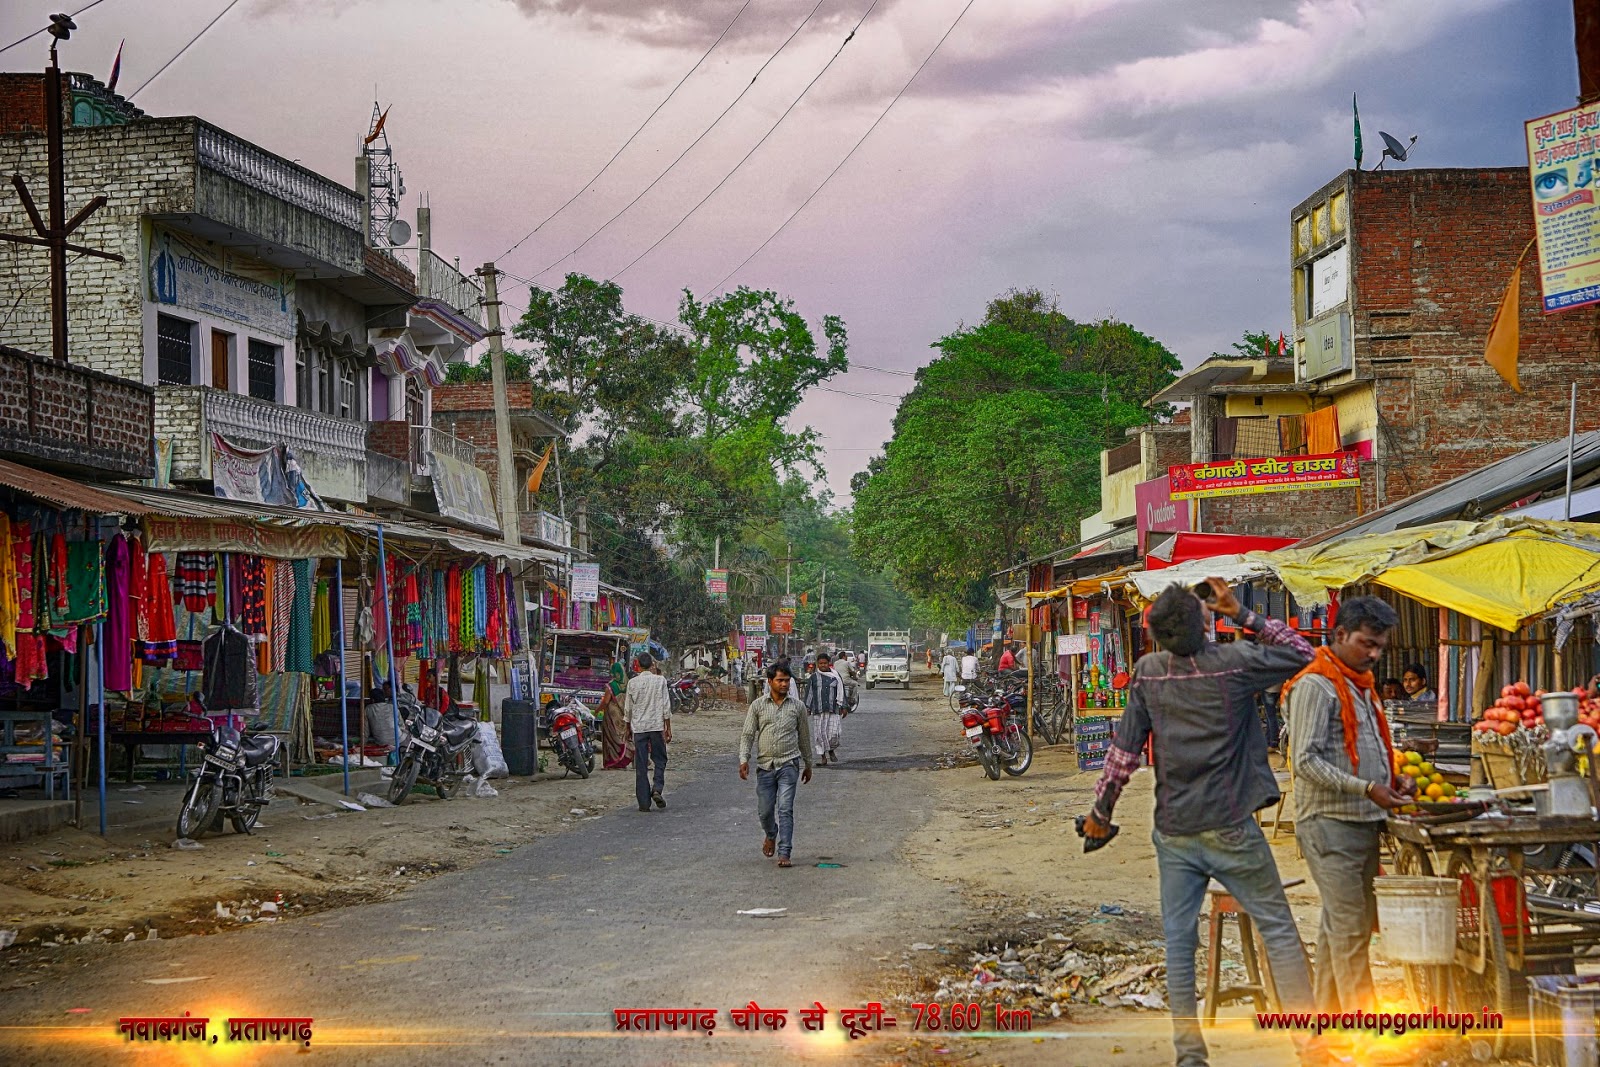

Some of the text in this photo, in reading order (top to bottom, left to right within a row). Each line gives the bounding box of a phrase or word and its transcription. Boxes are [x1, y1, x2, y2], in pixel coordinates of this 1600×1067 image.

[1194, 458, 1337, 481] बंगाली स्वीट हाउस
[1154, 501, 1176, 523] vodafone
